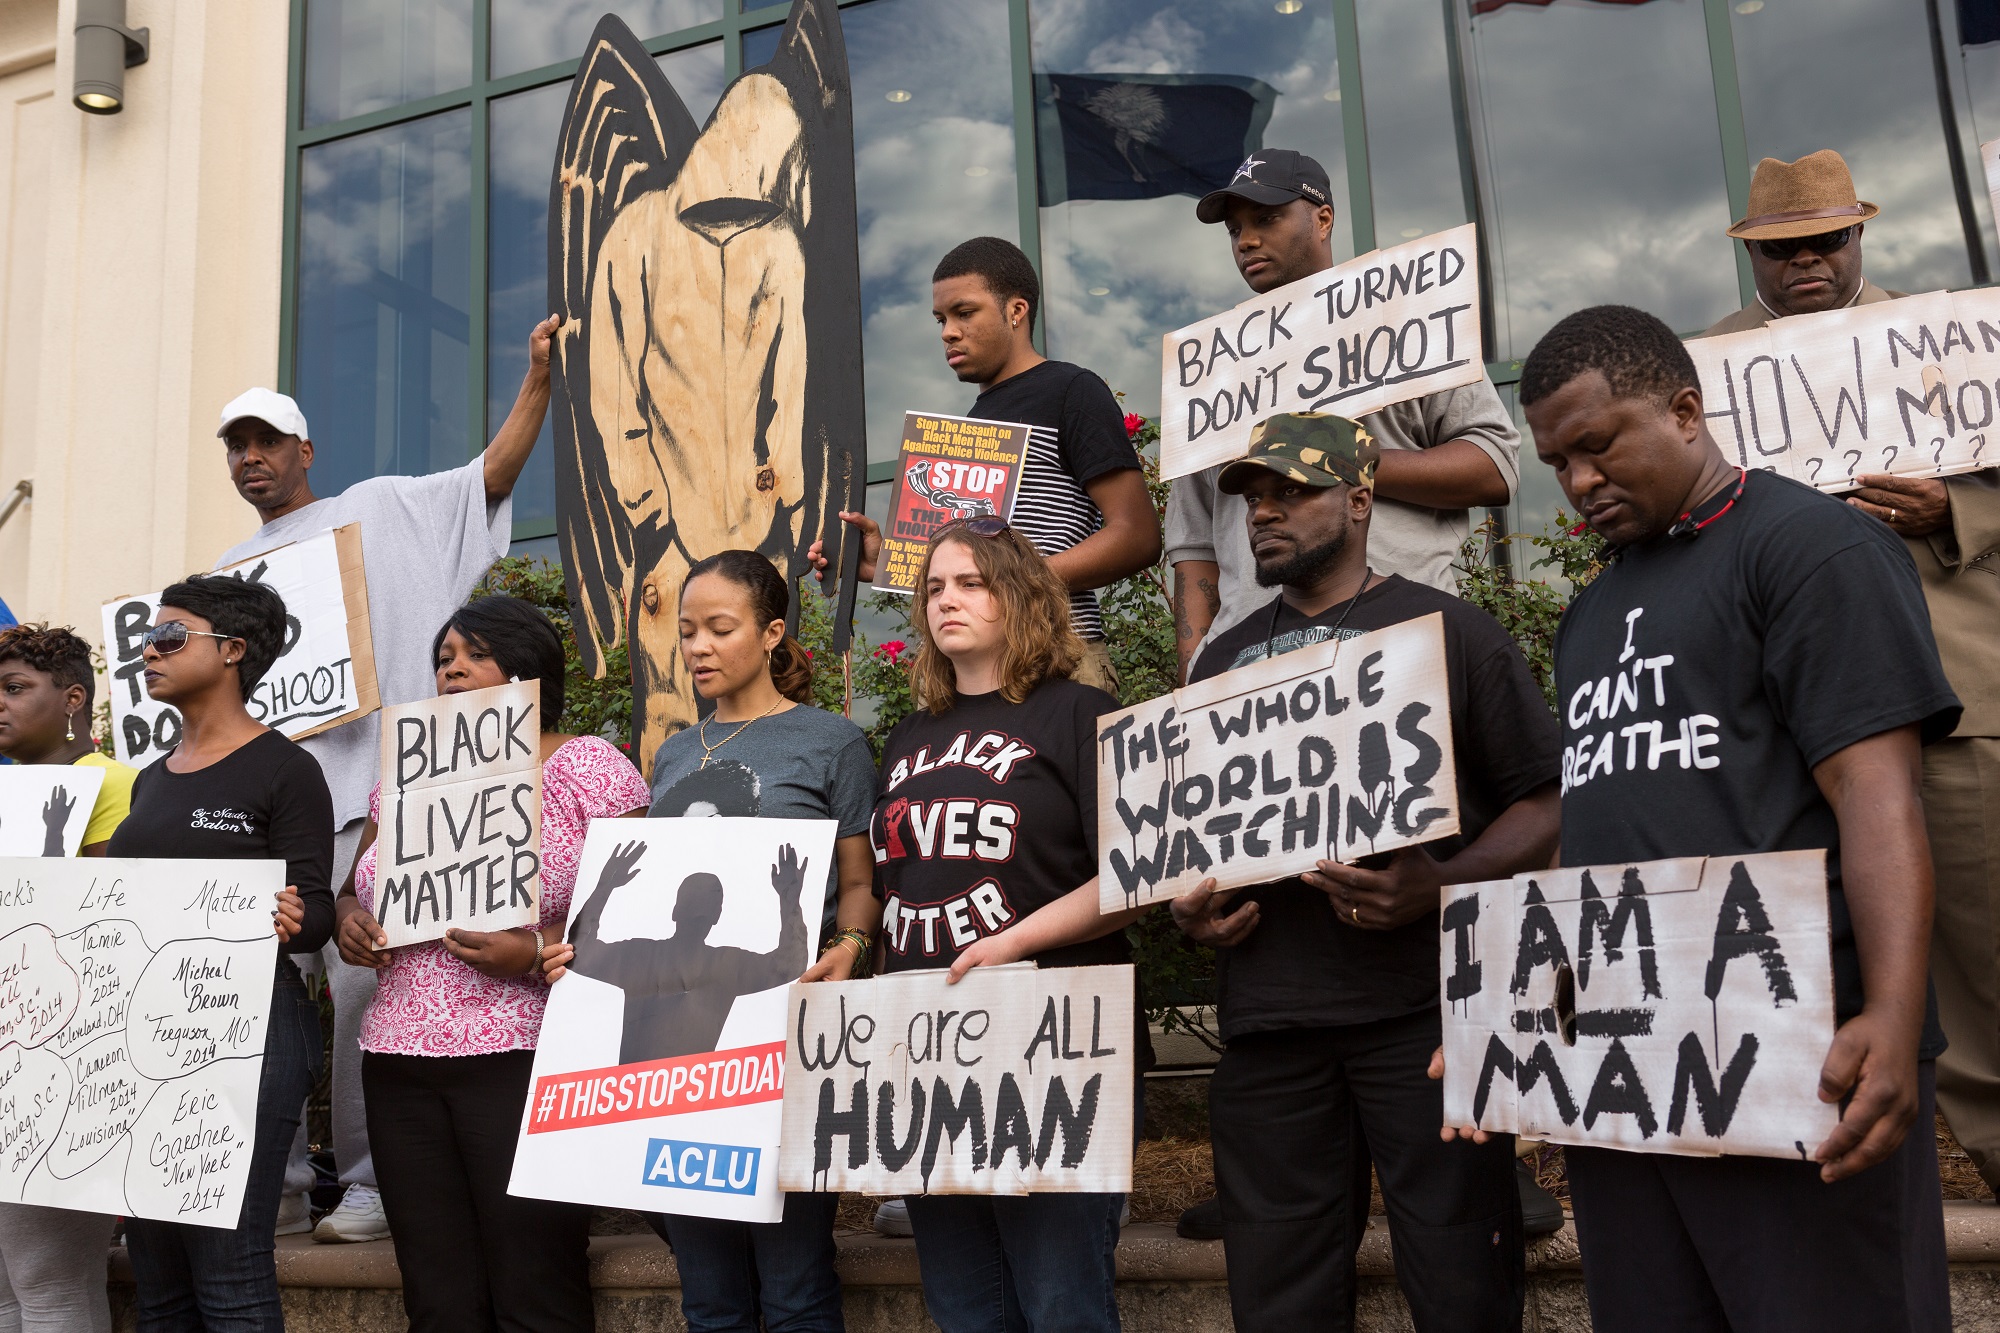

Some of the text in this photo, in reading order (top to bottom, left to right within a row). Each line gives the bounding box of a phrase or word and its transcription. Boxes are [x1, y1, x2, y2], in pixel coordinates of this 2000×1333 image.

[1302, 183, 1326, 202] Reebok
[1178, 247, 1466, 388] BACK TURNED
[1187, 303, 1472, 442] DON'T SHOOT
[1704, 336, 1868, 467] HOW
[1895, 377, 2000, 448] MO
[916, 417, 1012, 440] Stop The Assault on
[923, 429, 1001, 451] Black Men Rally
[902, 439, 1019, 464] Against Police Violence
[932, 461, 1006, 494] STOP
[897, 520, 939, 538] VIOLE
[911, 508, 946, 524] THE
[884, 539, 928, 554] The Next
[885, 562, 908, 573] Join
[890, 551, 904, 563] Be
[1304, 628, 1342, 643] MIKE
[1618, 607, 1644, 664] I
[249, 657, 352, 722] SHOOT
[1568, 654, 1674, 730] CAN'T
[1099, 650, 1385, 781] THE WHOLE
[396, 703, 534, 790] BLACK
[887, 732, 1034, 793] BLACK
[1115, 701, 1443, 836] WORLD IS
[190, 817, 241, 833] Salon
[396, 783, 534, 866] LIVES
[1110, 781, 1451, 894] WATCHING
[79, 877, 125, 911] Life
[378, 850, 540, 929] MATTER
[883, 880, 1013, 954] ATTER
[1441, 860, 1798, 1009] I AM A
[80, 957, 116, 988] Rice
[90, 976, 120, 1007] 2014
[173, 957, 231, 998] Micheal
[30, 991, 63, 1040] 2014
[797, 995, 1116, 1072] We are ALL
[182, 1045, 216, 1068] 2014
[69, 1079, 128, 1113] Tillman
[109, 1082, 137, 1115] 2014
[172, 1089, 218, 1125] Eric
[536, 1052, 786, 1123] #THISSTOPSTODAY
[1473, 1031, 1760, 1140] MAN
[813, 1071, 1102, 1178] HUMAN
[648, 1144, 754, 1189] ACLU
[178, 1184, 225, 1215] 2014
